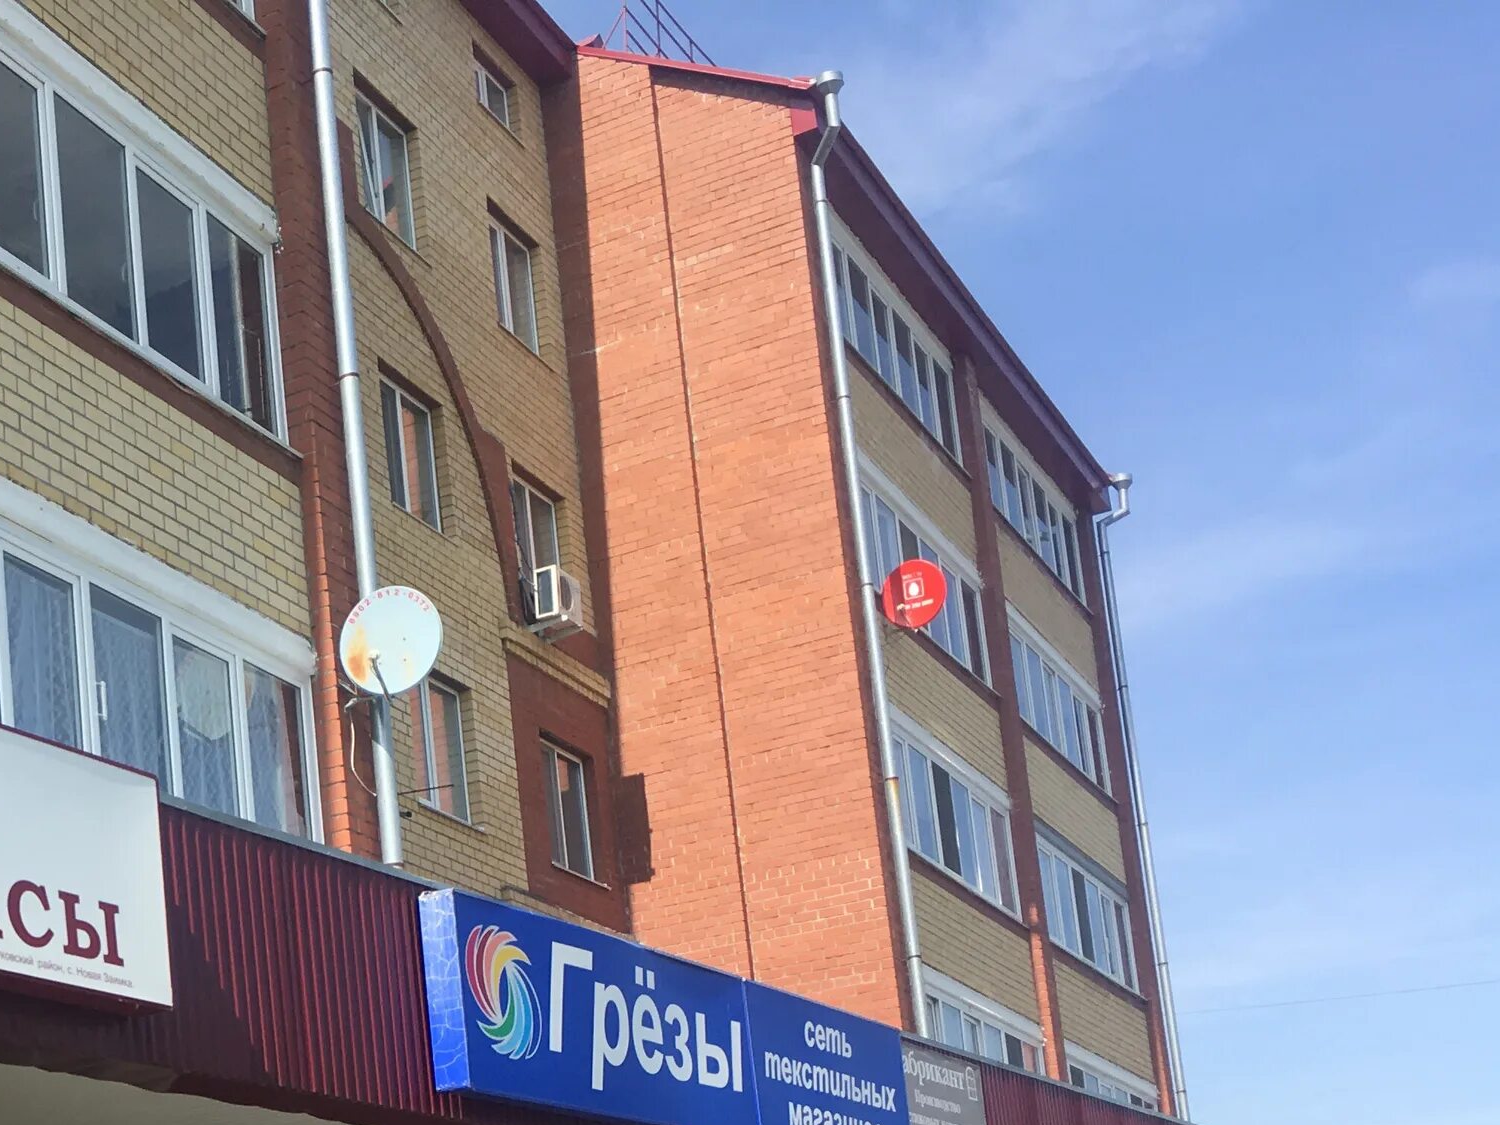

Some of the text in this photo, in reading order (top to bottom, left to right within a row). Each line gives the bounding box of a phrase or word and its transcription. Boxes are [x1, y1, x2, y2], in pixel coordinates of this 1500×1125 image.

[548, 941, 744, 1093] Грёзы
[804, 1020, 853, 1058] сеть
[764, 1051, 897, 1113] текстильных
